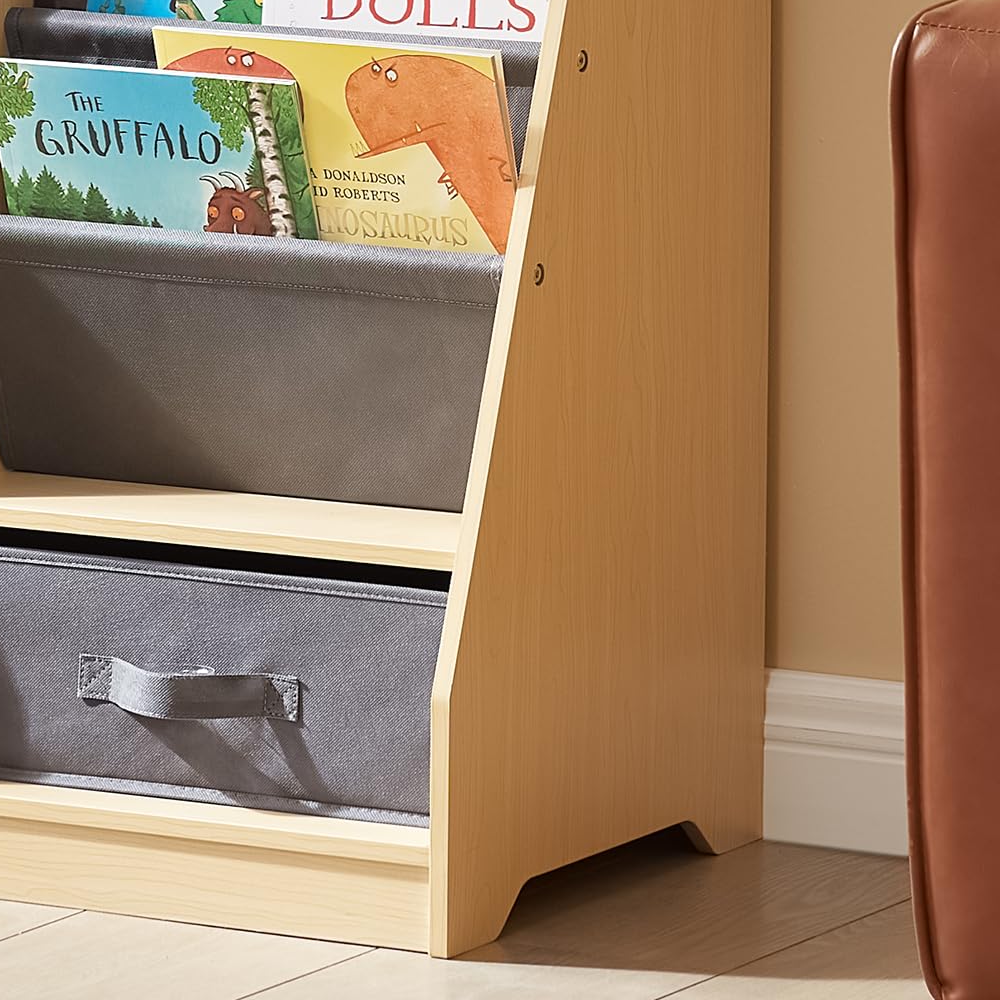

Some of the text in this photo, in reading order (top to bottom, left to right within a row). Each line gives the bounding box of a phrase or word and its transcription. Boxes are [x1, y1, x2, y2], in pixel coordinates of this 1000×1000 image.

[65, 91, 105, 112] THE
[35, 119, 221, 165] GRUFFALO
[324, 169, 406, 185] DONALDSON
[334, 188, 401, 203] ROBERTS
